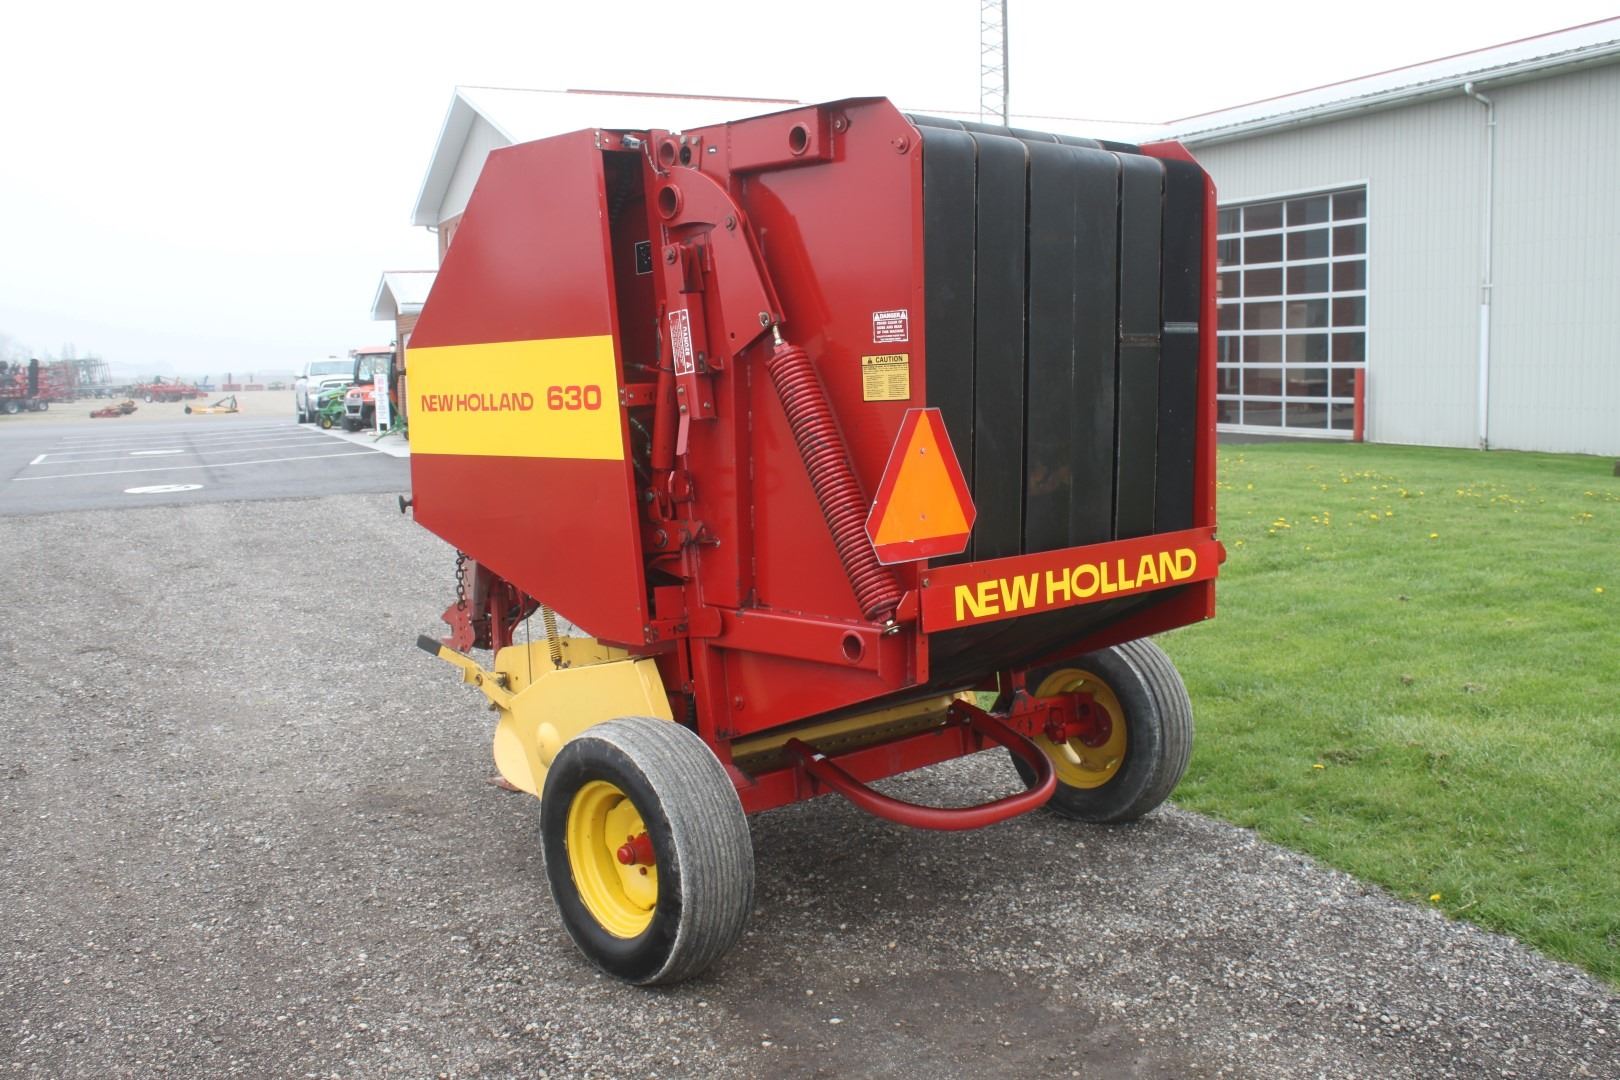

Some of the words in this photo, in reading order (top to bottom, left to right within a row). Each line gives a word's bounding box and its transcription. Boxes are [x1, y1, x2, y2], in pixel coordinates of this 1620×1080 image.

[421, 394, 454, 412] NEW
[456, 392, 534, 412] HOLLAND
[547, 384, 602, 411] 630
[954, 572, 1040, 621] NEW
[1045, 548, 1197, 605] HOLLAND
